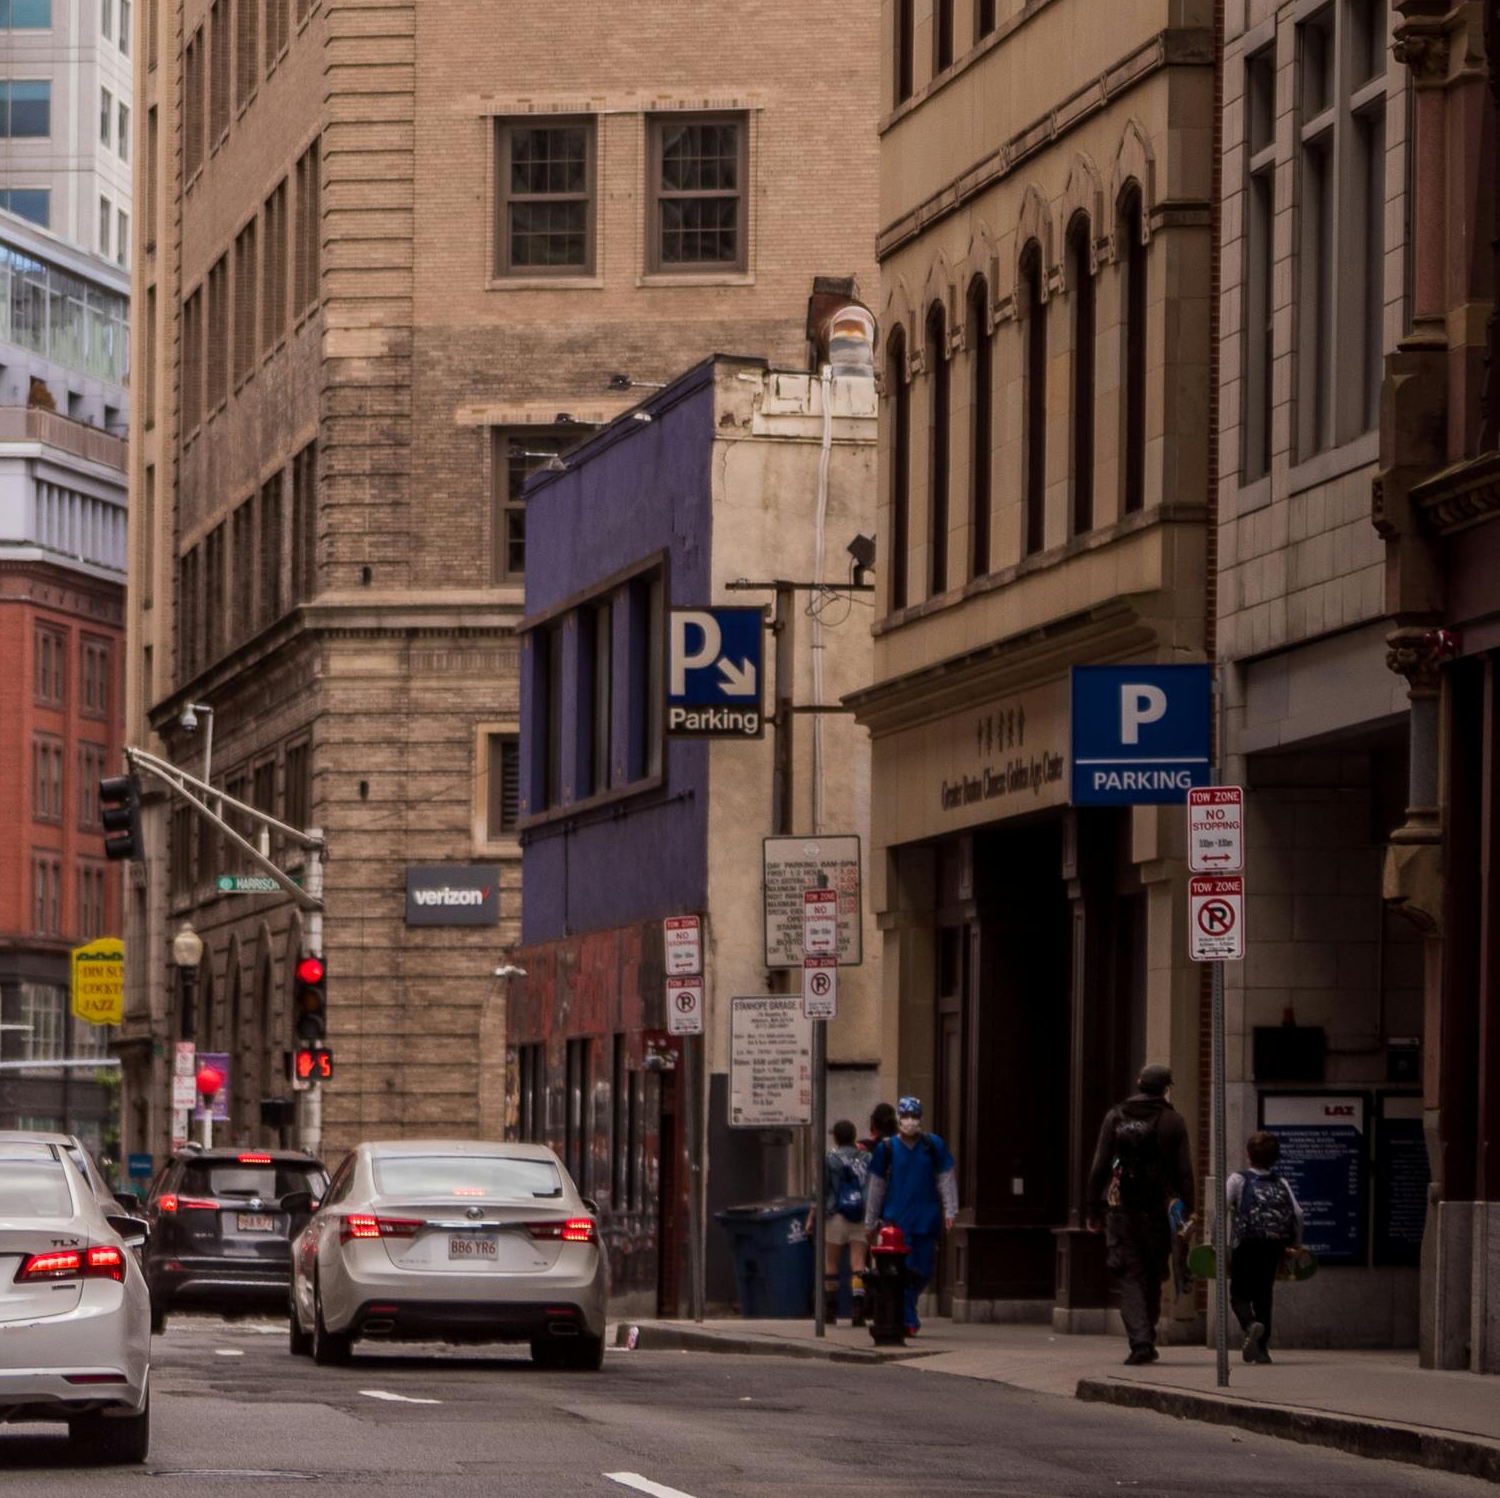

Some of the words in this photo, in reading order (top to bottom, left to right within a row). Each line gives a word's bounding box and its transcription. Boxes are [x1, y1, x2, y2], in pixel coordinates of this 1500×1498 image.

[670, 611, 722, 696] P
[1121, 683, 1167, 744] P
[669, 708, 758, 734] Parking
[1093, 771, 1191, 790] PARKING
[1191, 792, 1211, 803] TOW
[1214, 791, 1239, 802] ZONE
[1206, 809, 1225, 820] NO
[1192, 821, 1239, 831] STOPPING
[1193, 883, 1212, 893] TOW
[1215, 881, 1240, 892] ZONE
[414, 887, 483, 906] verizon
[676, 931, 689, 939] NO
[85, 999, 115, 1012] JAZZ
[318, 1054, 331, 1077] 5
[1324, 1106, 1355, 1116] LAZ
[51, 1239, 80, 1247] TLX
[475, 1241, 496, 1253] YR6
